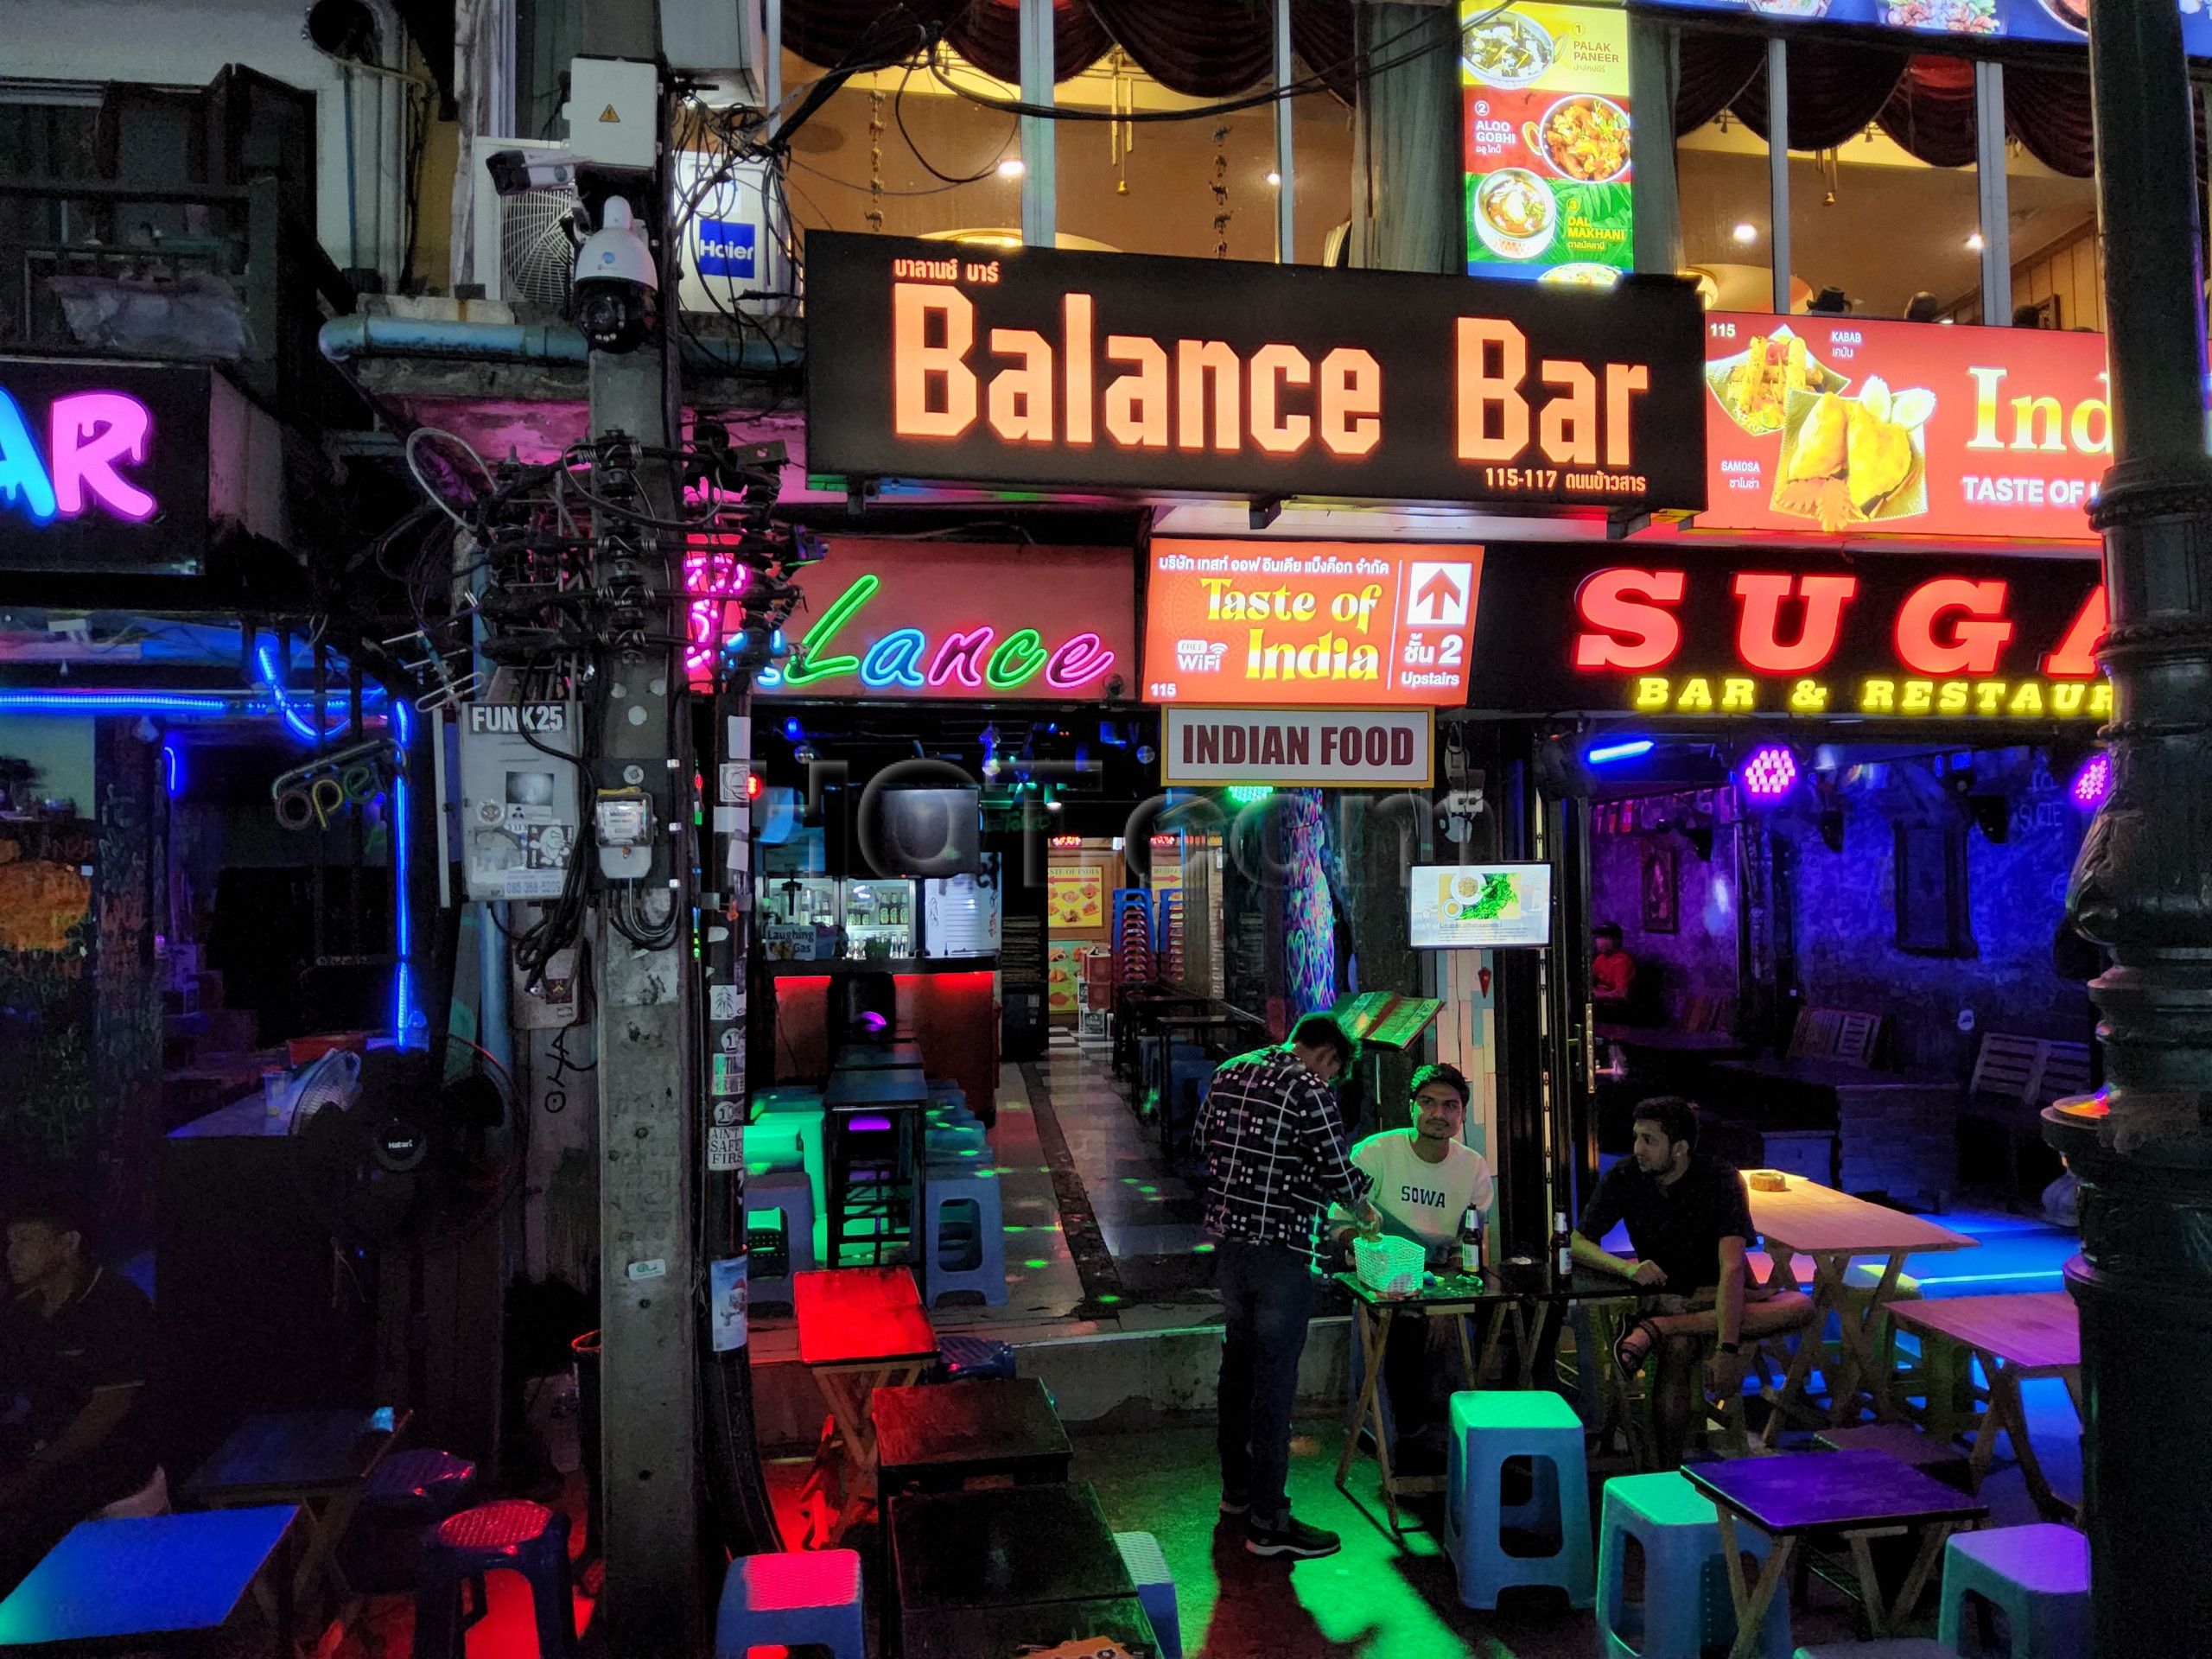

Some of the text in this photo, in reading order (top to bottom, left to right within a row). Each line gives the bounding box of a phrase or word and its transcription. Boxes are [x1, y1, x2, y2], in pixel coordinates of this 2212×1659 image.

[1573, 41, 1611, 52] PALAK
[1573, 52, 1619, 63] PANEER
[1476, 120, 1510, 131] ALOO
[1476, 131, 1515, 143] GOBHI
[1567, 216, 1591, 227] DAL
[1567, 227, 1624, 240] MAKHANI
[700, 239, 754, 261] Haier
[967, 261, 1000, 283] บาร์
[1710, 323, 1736, 337] 115
[1831, 331, 1861, 343] KABAB
[893, 283, 1649, 466] Balance Bar
[1721, 461, 1760, 472] SAMOSA
[1486, 467, 1558, 489] 115-117
[1962, 476, 2044, 504] TASTE
[2049, 480, 2084, 504] OF
[1231, 557, 1261, 572] ออฟ
[1262, 557, 1301, 573] อินเดีย
[1200, 577, 1383, 635] Taste of
[1181, 643, 1204, 652] FREE
[1244, 628, 1380, 682] India
[1404, 632, 1464, 665] ชั้น 2
[1177, 654, 1221, 671] WiFi
[1402, 671, 1460, 687] Upstairs
[1150, 683, 1177, 696] 115
[1636, 677, 1755, 709] BAR
[1792, 678, 1828, 709] &
[472, 705, 563, 732] FUNK25
[1182, 724, 1414, 767] INDIAN FOOD
[275, 761, 386, 830] ope
[767, 929, 814, 943] Laughing
[794, 942, 812, 952] Gas
[1401, 1185, 1446, 1208] SOWA
